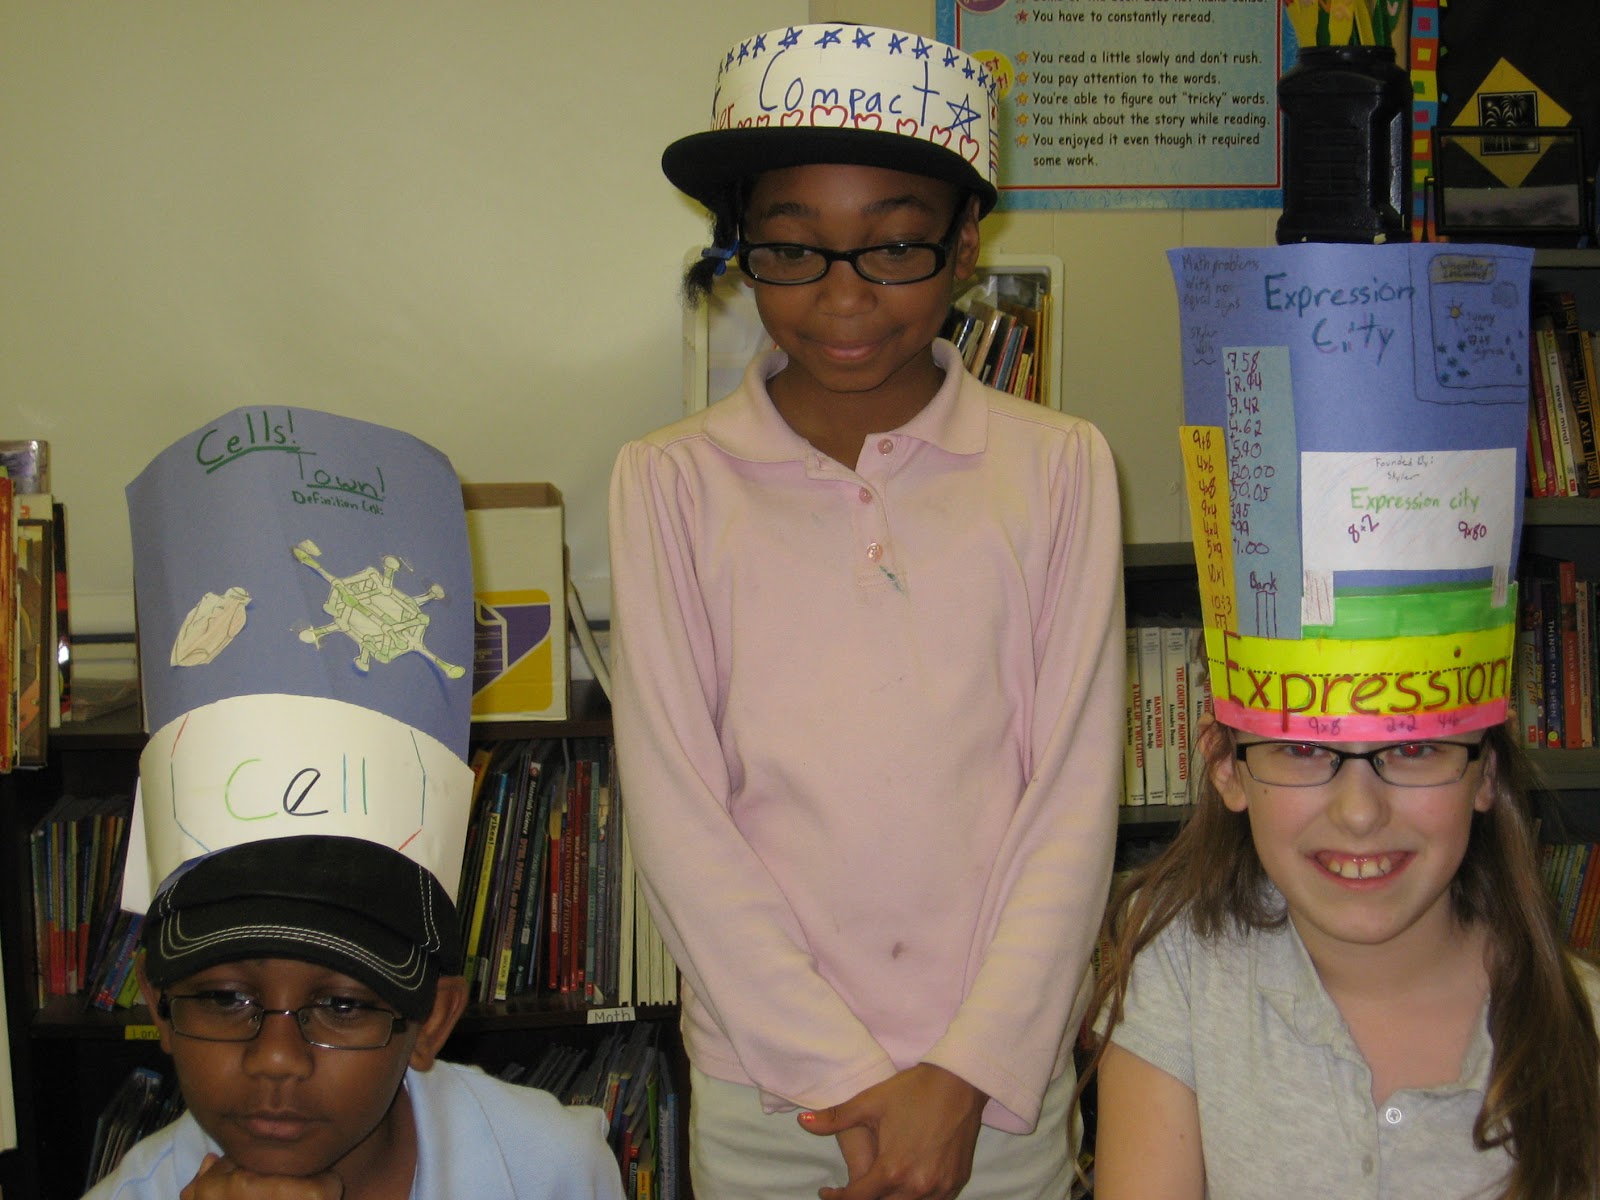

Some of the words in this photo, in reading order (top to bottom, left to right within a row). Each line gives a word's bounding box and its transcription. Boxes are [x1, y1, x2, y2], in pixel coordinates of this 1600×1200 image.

[1033, 10, 1053, 21] You
[1059, 10, 1084, 21] have
[1091, 10, 1102, 21] to
[1108, 10, 1167, 25] constantly
[1172, 10, 1215, 21] reread.
[1033, 51, 1054, 63] You
[1058, 51, 1085, 63] read
[1090, 54, 1097, 63] a
[1102, 51, 1130, 63] little
[1136, 51, 1170, 67] slowly
[1175, 51, 1195, 63] and
[1200, 51, 1228, 63] don't
[1233, 51, 1262, 63] rush.
[759, 49, 940, 127] Compact
[1033, 72, 1054, 84] You
[1059, 72, 1078, 87] pay
[1083, 72, 1136, 84] attention
[1142, 72, 1154, 84] to
[1160, 72, 1178, 84] the
[1183, 72, 1220, 84] words.
[1033, 92, 1068, 105] You're
[1074, 92, 1098, 105] able
[1103, 92, 1115, 105] to
[1121, 92, 1153, 108] figure
[1159, 92, 1177, 105] out
[1232, 92, 1269, 105] words.
[1033, 113, 1054, 125] You
[1059, 113, 1088, 125] think
[1093, 113, 1126, 125] about
[1131, 113, 1150, 125] the
[1155, 113, 1185, 129] story
[1190, 113, 1219, 125] while
[1224, 113, 1270, 129] reading.
[1033, 133, 1054, 146] You
[1058, 133, 1104, 149] enjoyed
[1109, 133, 1118, 146] it
[1123, 133, 1149, 146] even
[1154, 133, 1193, 149] though
[1198, 133, 1207, 146] it
[1212, 133, 1260, 149] required
[1033, 156, 1061, 166] some
[1067, 154, 1098, 167] work.
[1264, 272, 1416, 317] Expression
[1312, 313, 1394, 366] City
[1555, 385, 1564, 413] never
[196, 409, 296, 467] Cells!
[1580, 420, 1592, 444] AVI
[1375, 455, 1412, 467] Founded
[292, 490, 359, 510] Definition
[1350, 487, 1440, 513] Expression
[1450, 488, 1481, 513] city
[1177, 666, 1185, 681] THE
[1223, 630, 1509, 733] Expression
[1154, 695, 1162, 715] HANS
[1177, 684, 1185, 709] COUNT
[1178, 712, 1186, 722] OF
[1135, 724, 1143, 743] TWO
[1178, 723, 1187, 750] MONTE
[1179, 753, 1187, 780] CRISTO
[526, 780, 537, 811] Materials
[522, 810, 532, 835] Science
